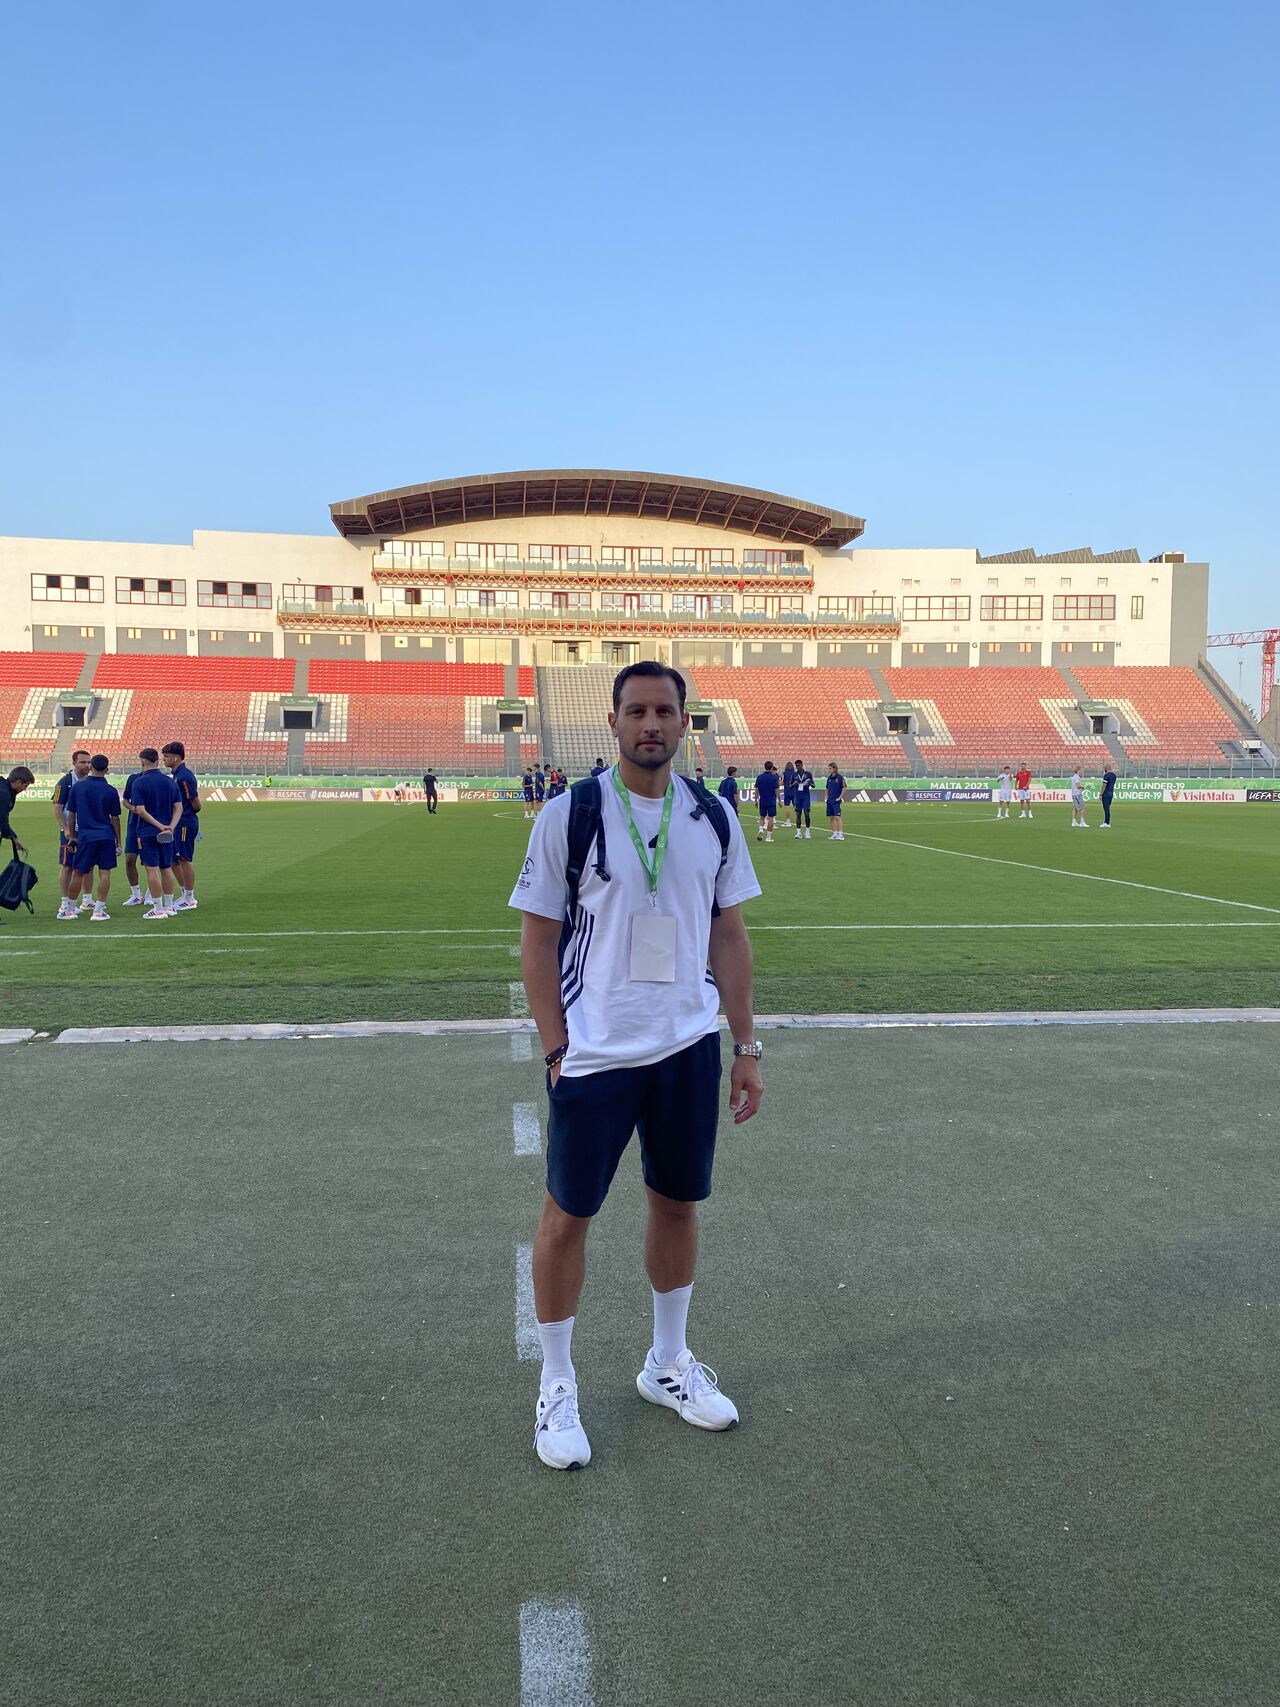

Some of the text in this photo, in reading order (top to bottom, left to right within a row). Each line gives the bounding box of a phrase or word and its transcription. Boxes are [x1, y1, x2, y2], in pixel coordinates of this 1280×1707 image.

[735, 641, 741, 649] F
[197, 779, 263, 788] MALTA 2023
[930, 782, 989, 790] MALTA 2023
[1114, 782, 1185, 790] UEFA UNDER-19
[339, 791, 360, 799] GAME
[460, 790, 487, 800] UEFA
[915, 791, 942, 799] RESPECT
[971, 791, 991, 800] GAME
[1118, 791, 1162, 800] UNDER-19
[1183, 791, 1235, 801] VisitMalta
[1249, 791, 1272, 800] UEFA
